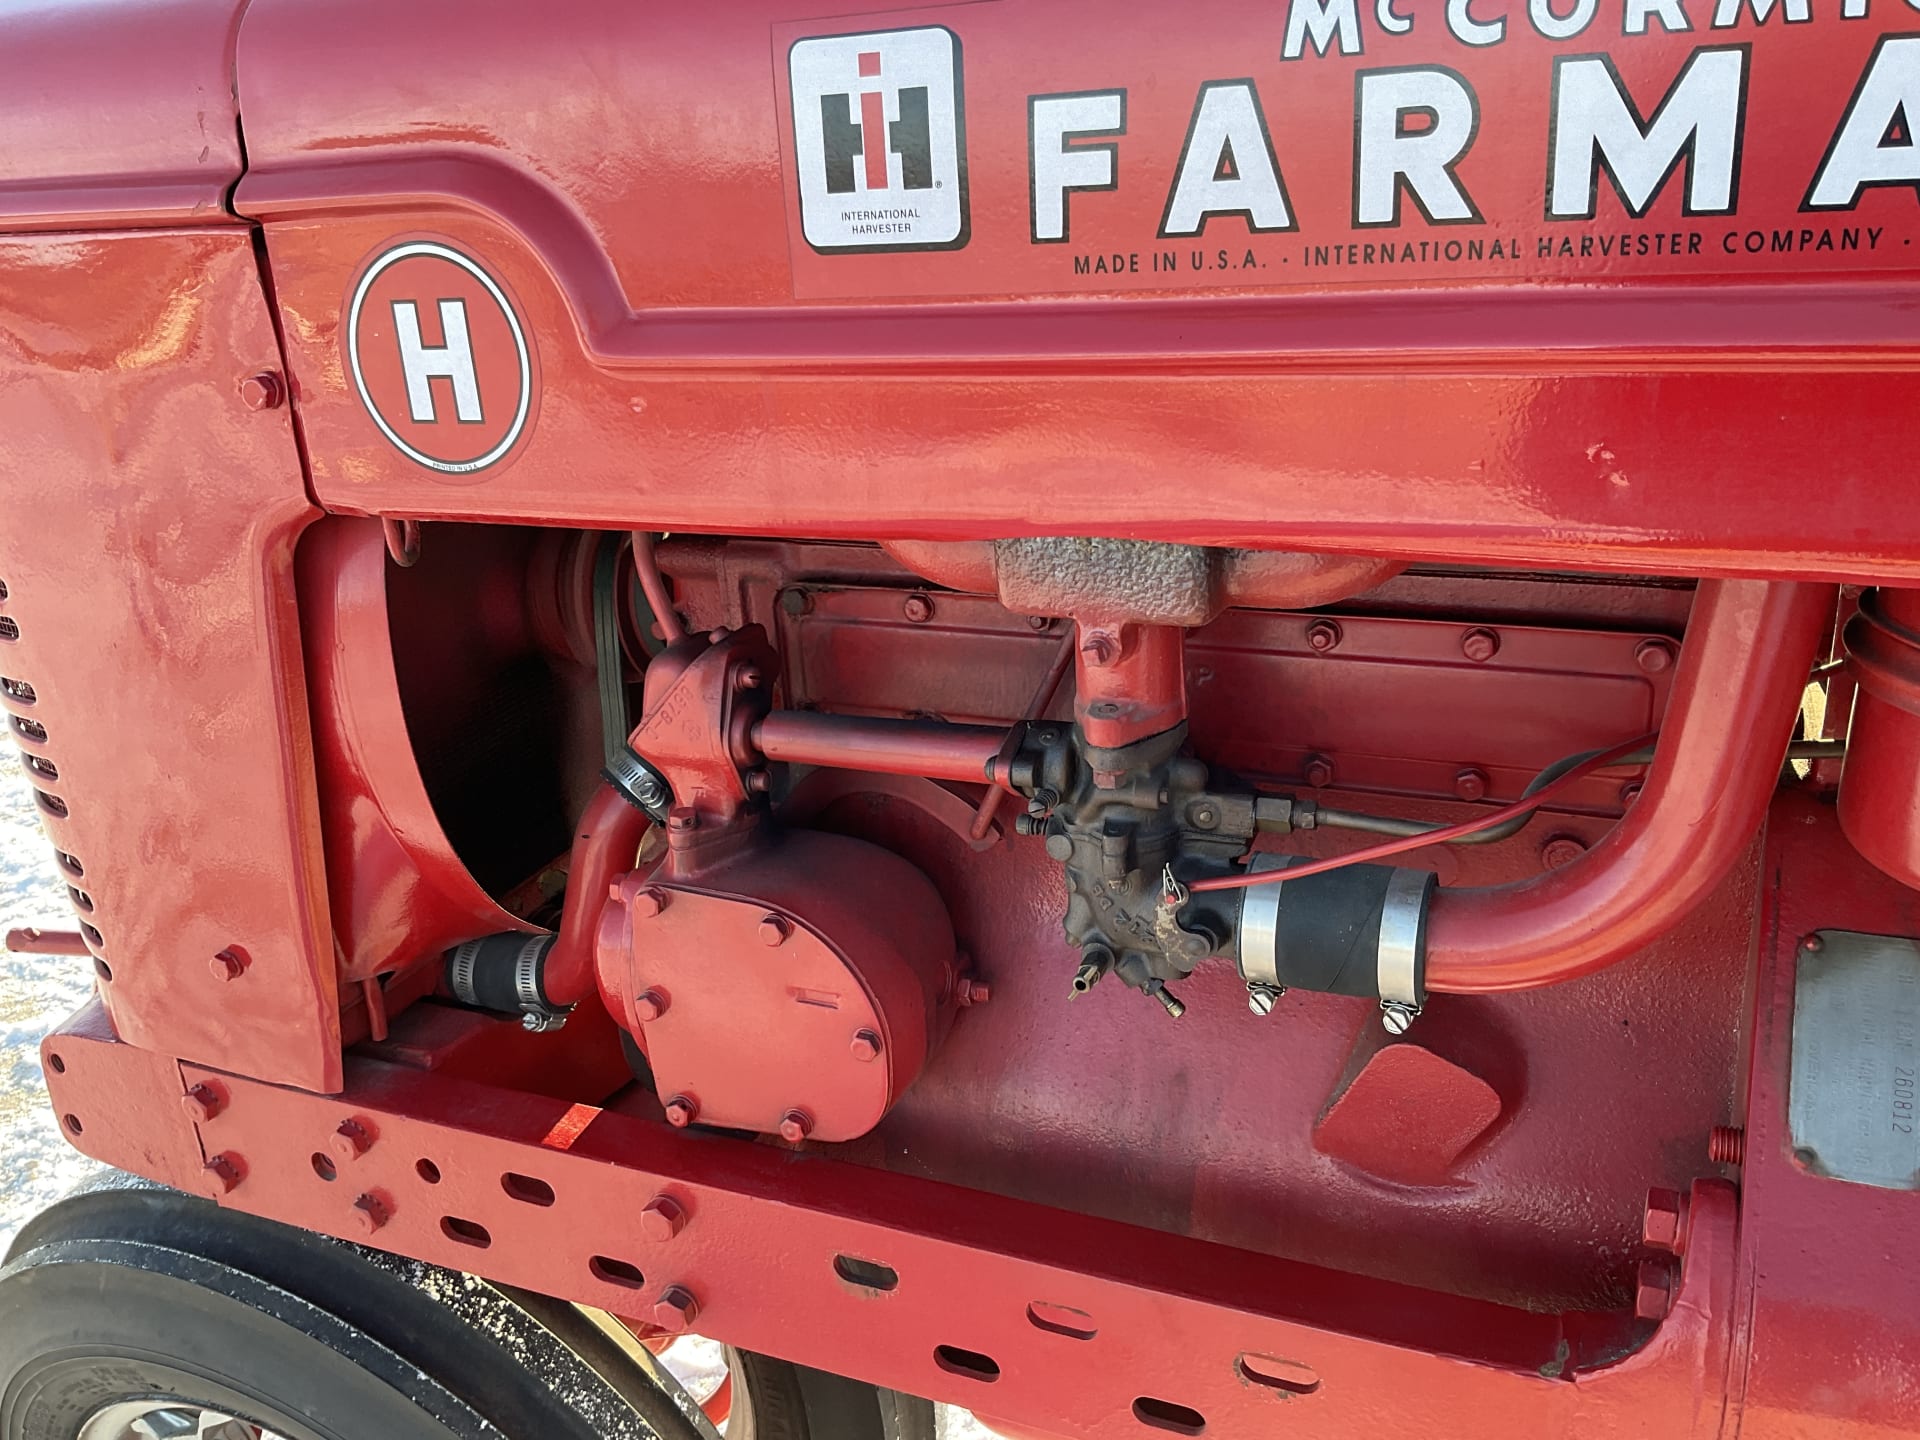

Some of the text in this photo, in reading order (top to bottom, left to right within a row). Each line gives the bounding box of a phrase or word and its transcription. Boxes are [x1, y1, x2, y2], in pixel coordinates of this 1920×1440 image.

[1027, 31, 1920, 244] FARMA
[841, 208, 921, 222] INTERNATIONAL
[852, 223, 912, 235] HARVESTER
[1074, 227, 1884, 275] MADE IN U.S.A. INTERNATIONAL HARVESTER COMPANY
[390, 297, 486, 425] H
[1891, 1066, 1916, 1135] 260812
